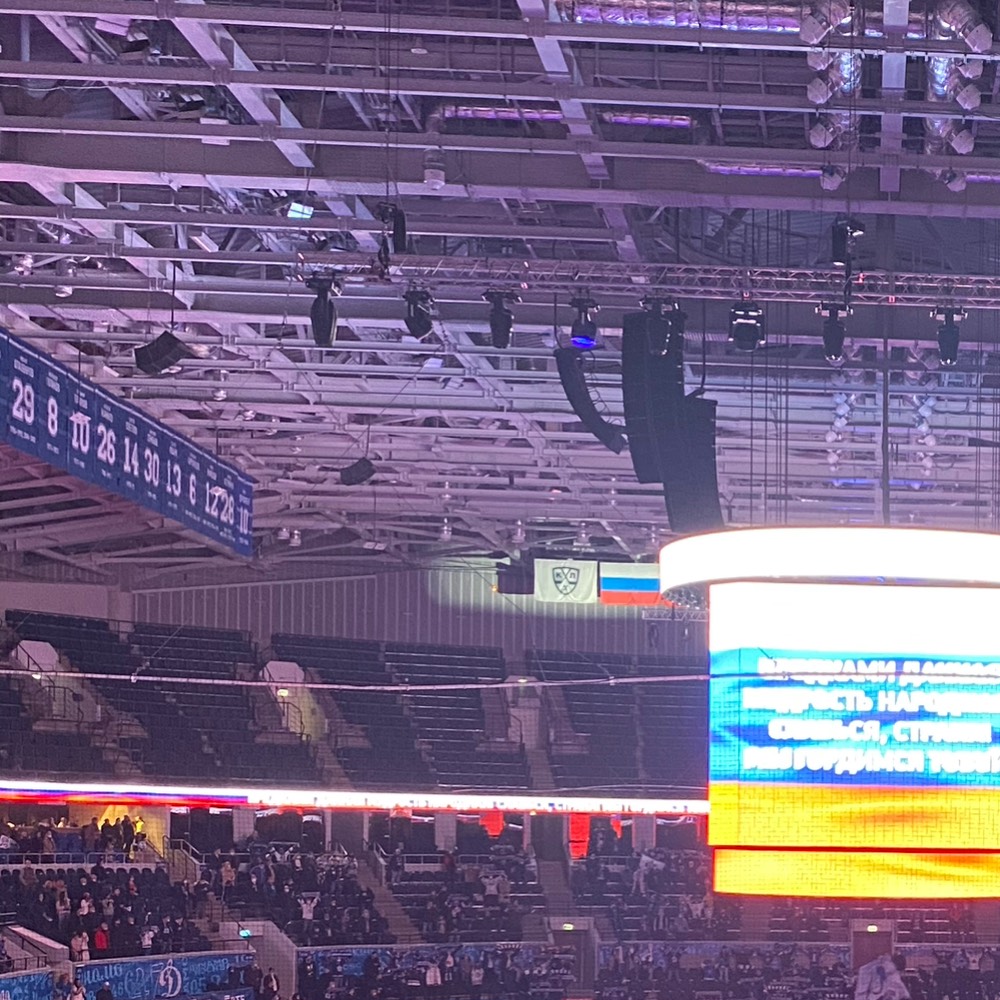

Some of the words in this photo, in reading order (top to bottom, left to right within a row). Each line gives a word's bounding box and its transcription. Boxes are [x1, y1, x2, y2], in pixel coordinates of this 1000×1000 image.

[12, 376, 34, 425] 29
[47, 395, 58, 437] 8
[97, 422, 116, 465] 26
[123, 436, 139, 477] 14
[144, 447, 160, 487] 30
[166, 459, 181, 497] 13
